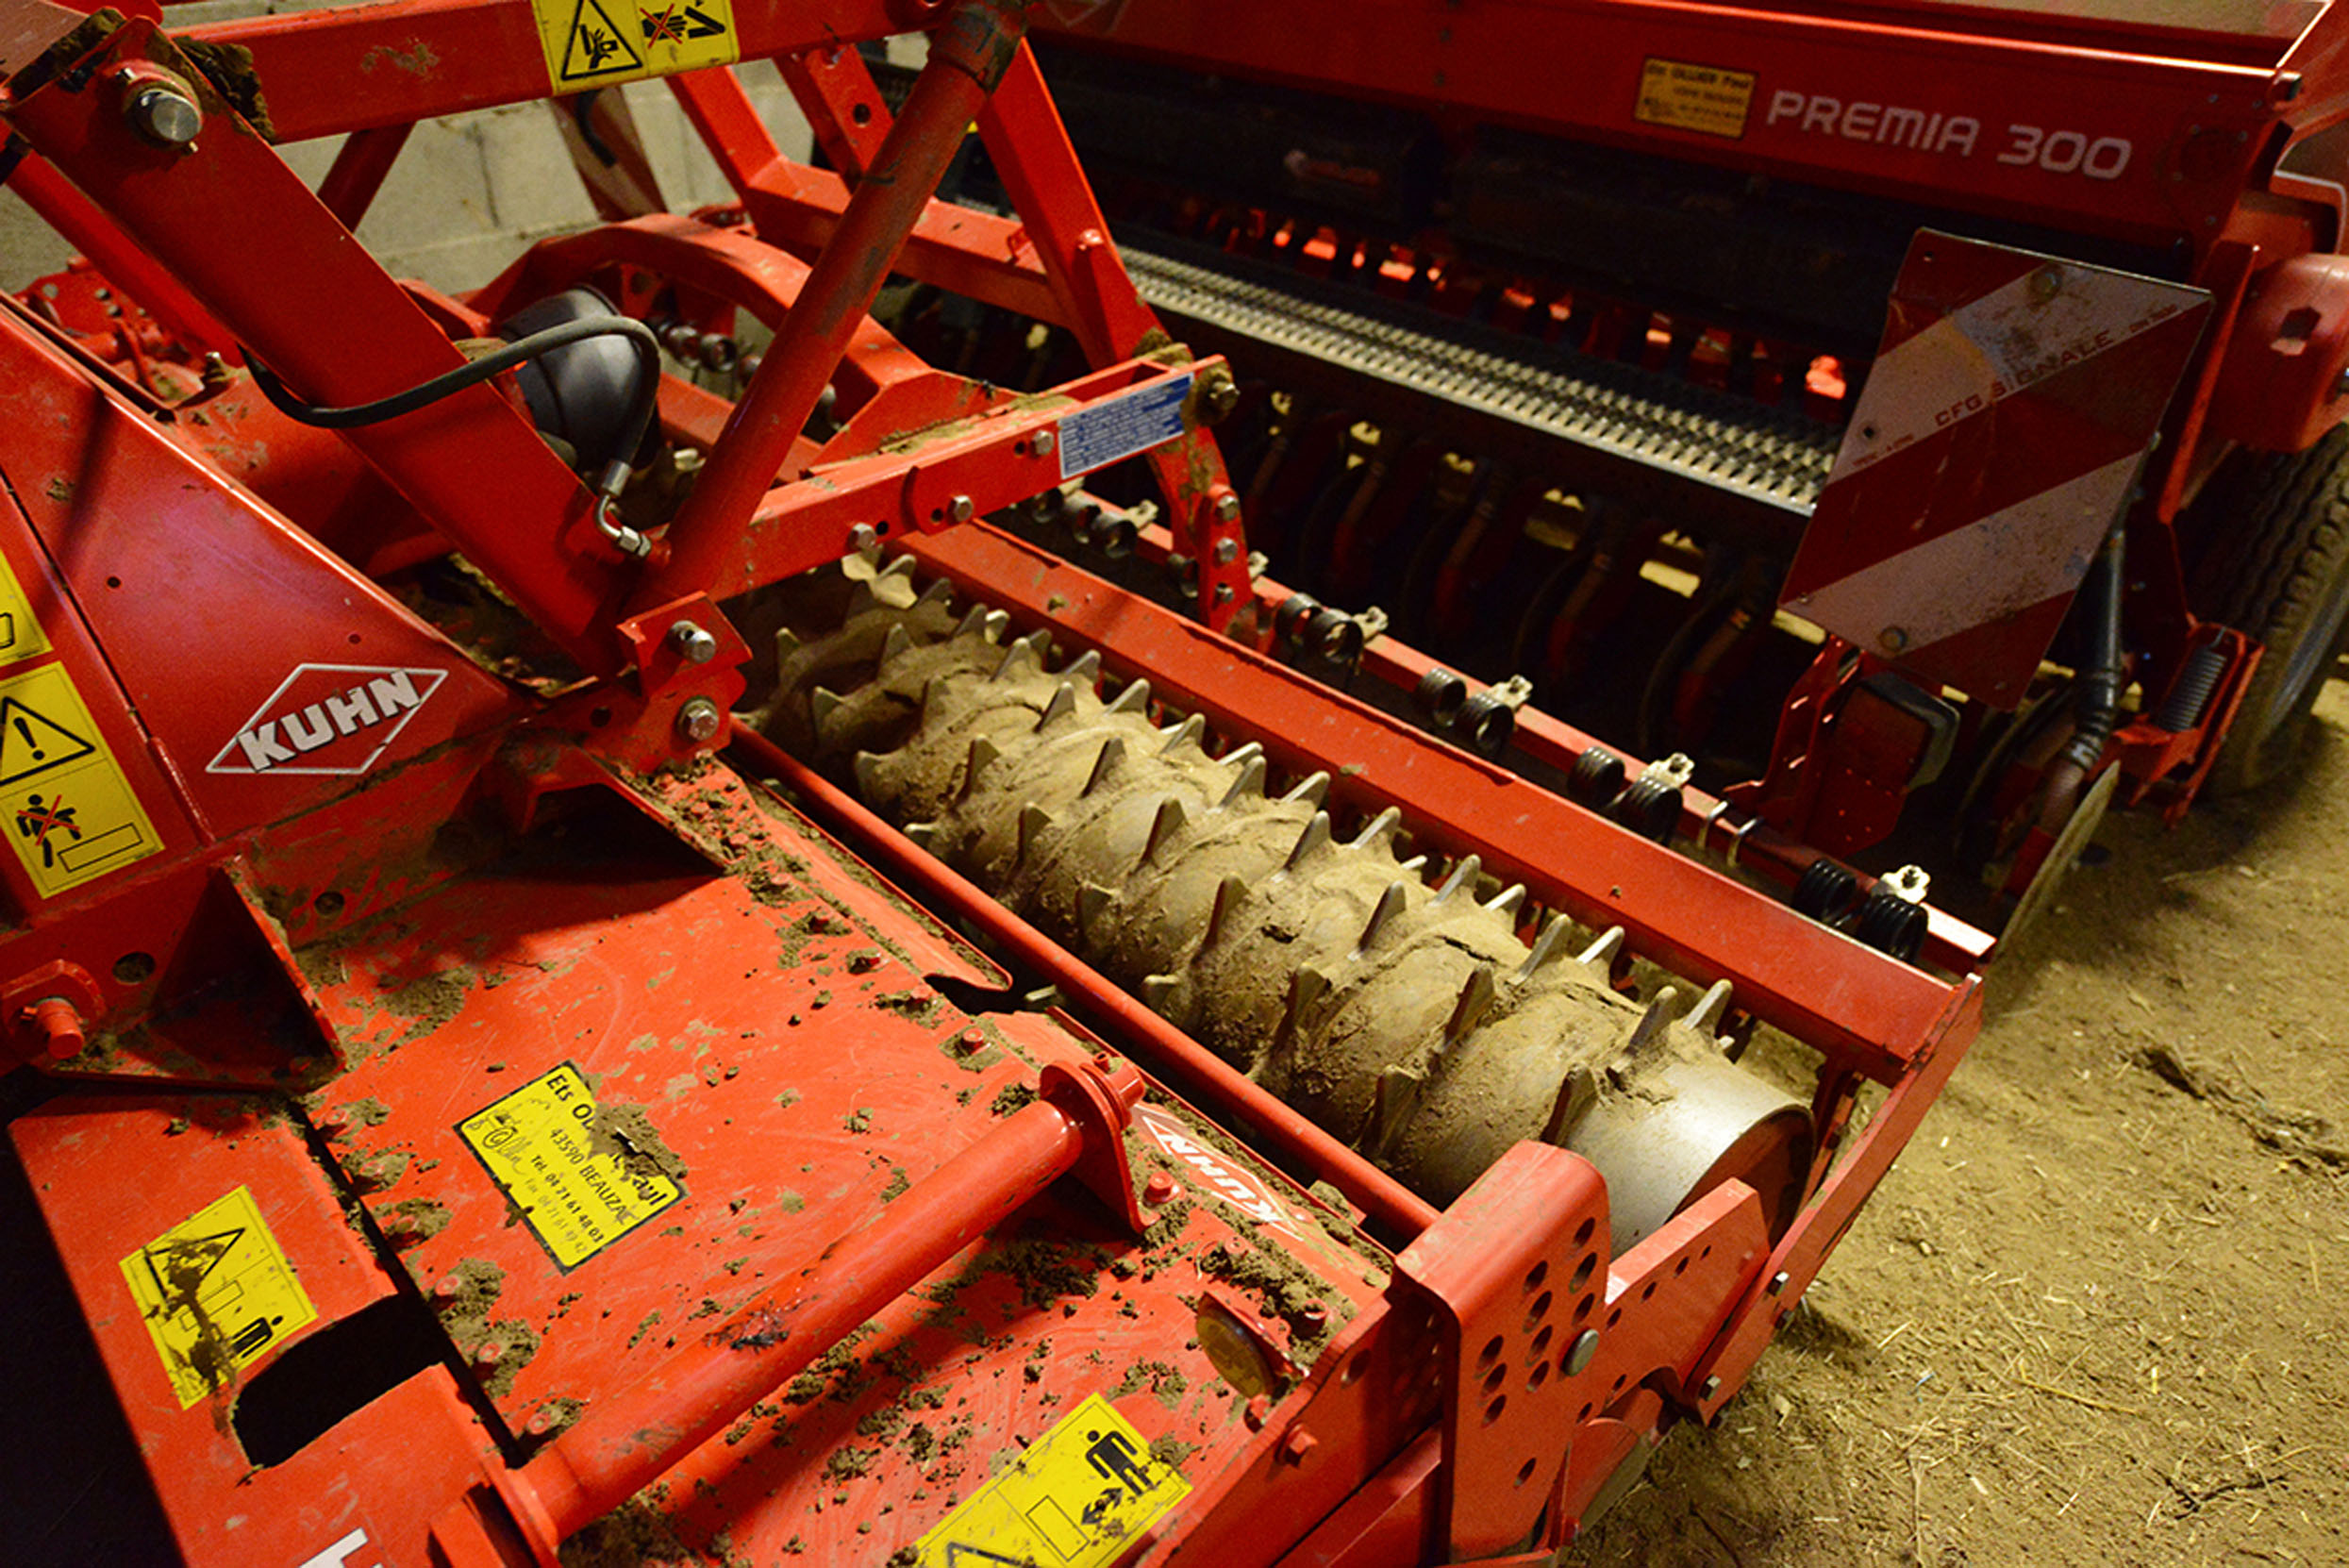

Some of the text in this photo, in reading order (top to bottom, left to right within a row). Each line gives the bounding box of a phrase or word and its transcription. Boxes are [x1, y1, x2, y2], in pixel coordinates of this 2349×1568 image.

[1766, 89, 1980, 158] PREMIA
[1996, 124, 2133, 180] 300
[1935, 392, 1983, 426] CFG
[238, 668, 421, 772] KUHN
[546, 1074, 574, 1101] Ets
[550, 1128, 585, 1165] 43590
[1158, 1134, 1283, 1222] KUHN
